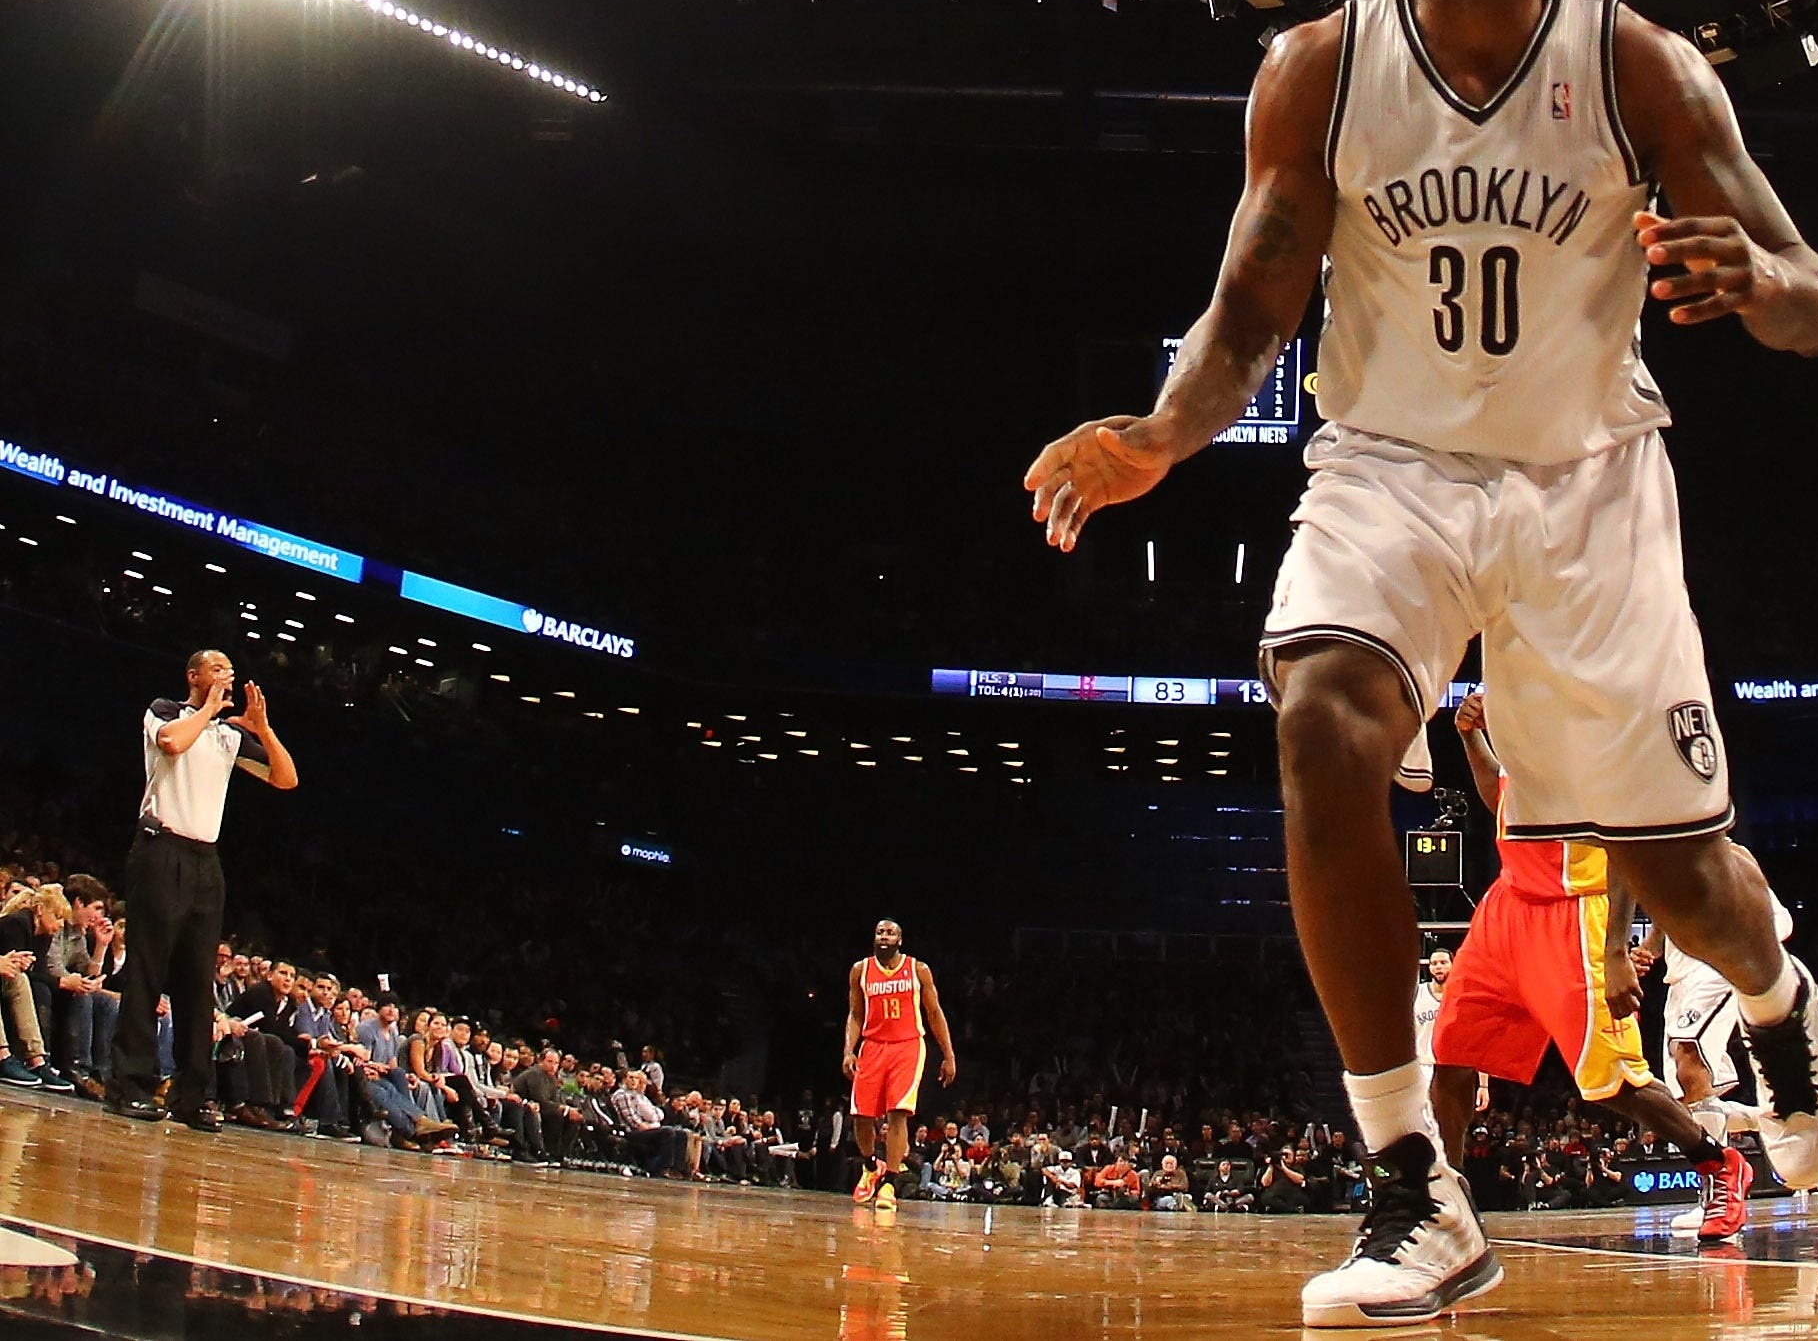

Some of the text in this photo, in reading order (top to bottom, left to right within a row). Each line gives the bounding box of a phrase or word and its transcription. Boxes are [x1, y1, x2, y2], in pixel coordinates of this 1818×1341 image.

[1363, 165, 1592, 247] BROOKLYN
[1428, 245, 1520, 356] 30
[1275, 407, 1283, 417] 2
[1259, 427, 1288, 443] NETS
[0, 440, 339, 571] Wealth and Investment Management
[542, 615, 635, 658] BARCLAYS
[1007, 674, 1017, 685] 3
[1735, 680, 1797, 699] Wealth
[1155, 681, 1187, 703] 83
[1416, 837, 1447, 853] 13.1
[866, 978, 914, 996] HOUSTON
[882, 997, 902, 1020] 13
